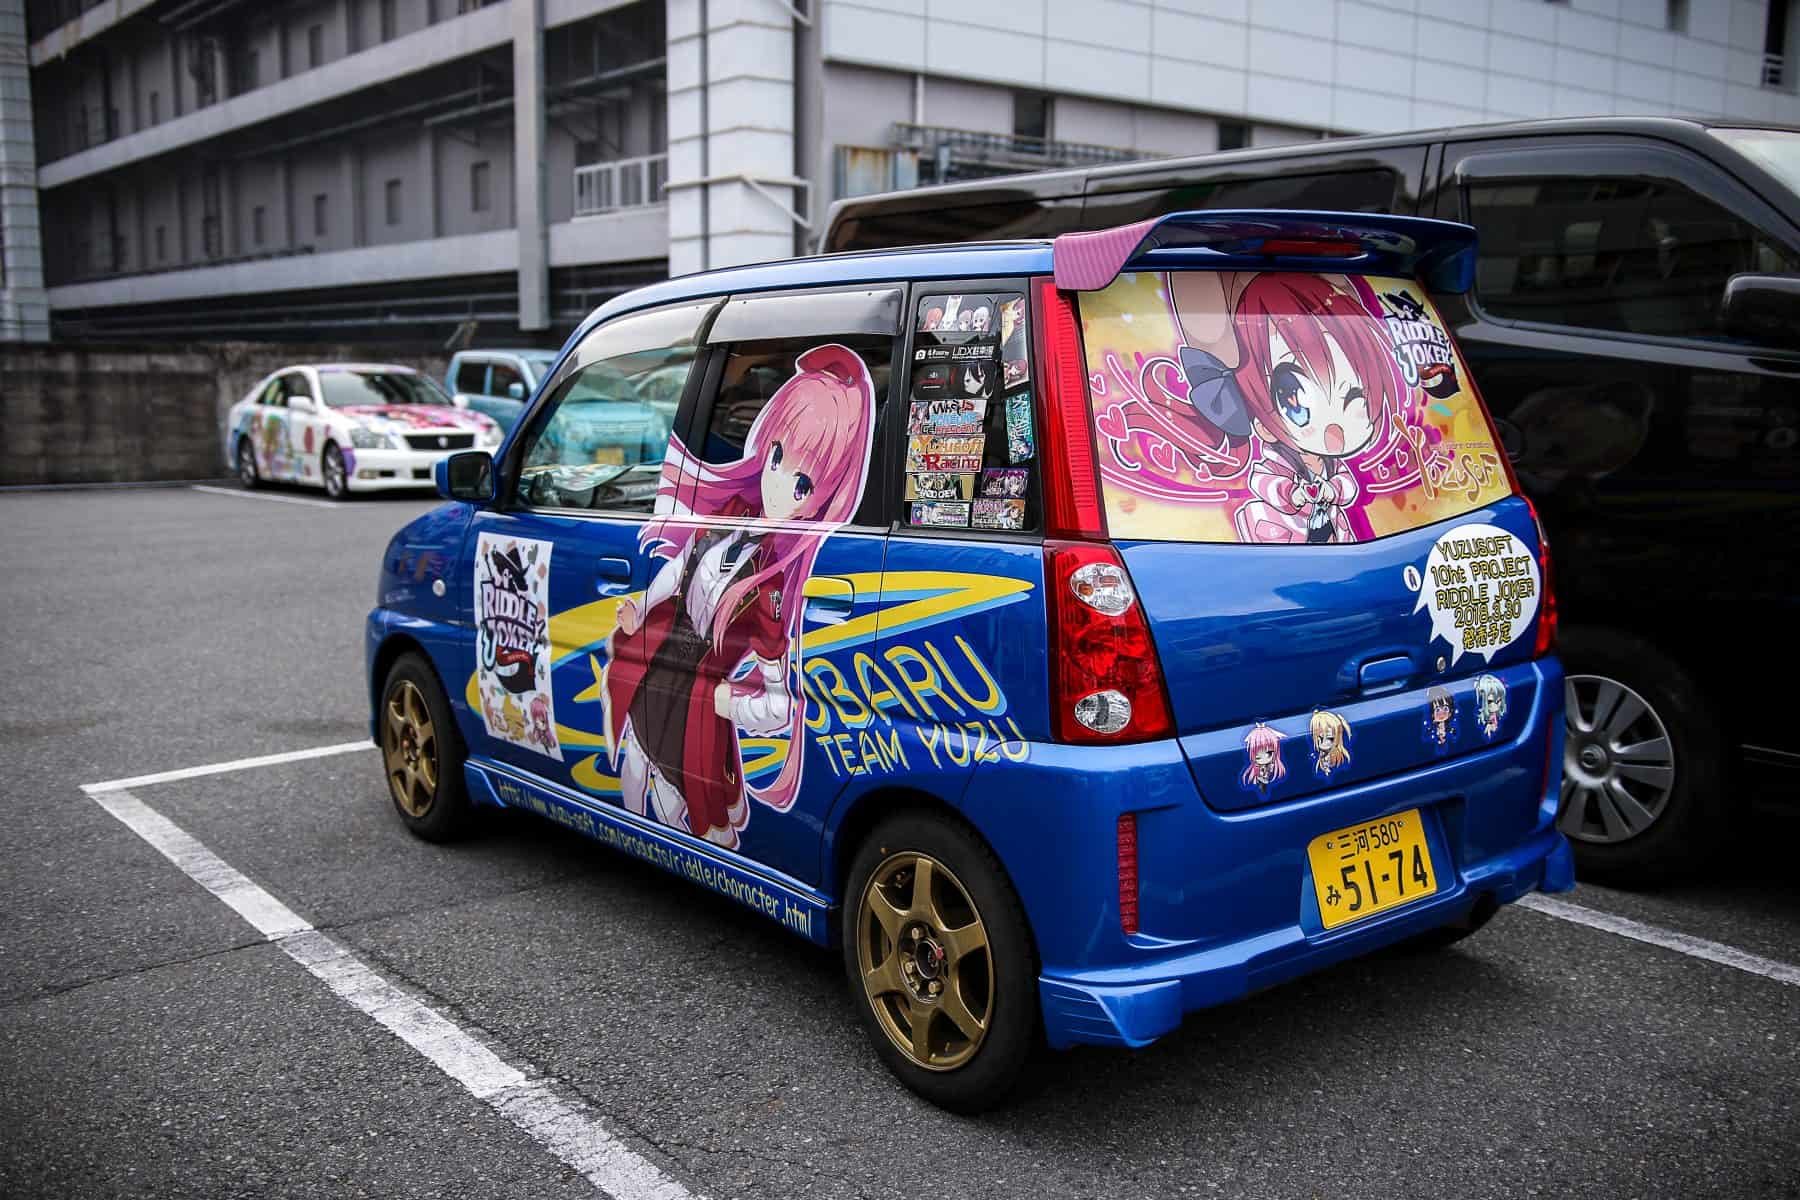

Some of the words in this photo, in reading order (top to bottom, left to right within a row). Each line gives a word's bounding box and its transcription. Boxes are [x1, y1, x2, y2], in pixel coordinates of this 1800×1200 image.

[1386, 316, 1446, 347] RIDDLE
[1393, 339, 1453, 389] JOKER
[923, 454, 981, 472] Racing
[1437, 534, 1513, 562] YUZUSOFT
[1469, 556, 1531, 581] PROJECT
[481, 580, 538, 629] RIDDLE
[1435, 584, 1490, 611] RIDDLE
[1495, 577, 1536, 603] JOKER
[1454, 598, 1523, 629] 2018.3.30
[482, 618, 545, 672] JOKER
[1462, 620, 1513, 650] 発売予定
[815, 727, 912, 777] TEAM
[915, 715, 1032, 770] YUZU
[1325, 884, 1342, 907] み
